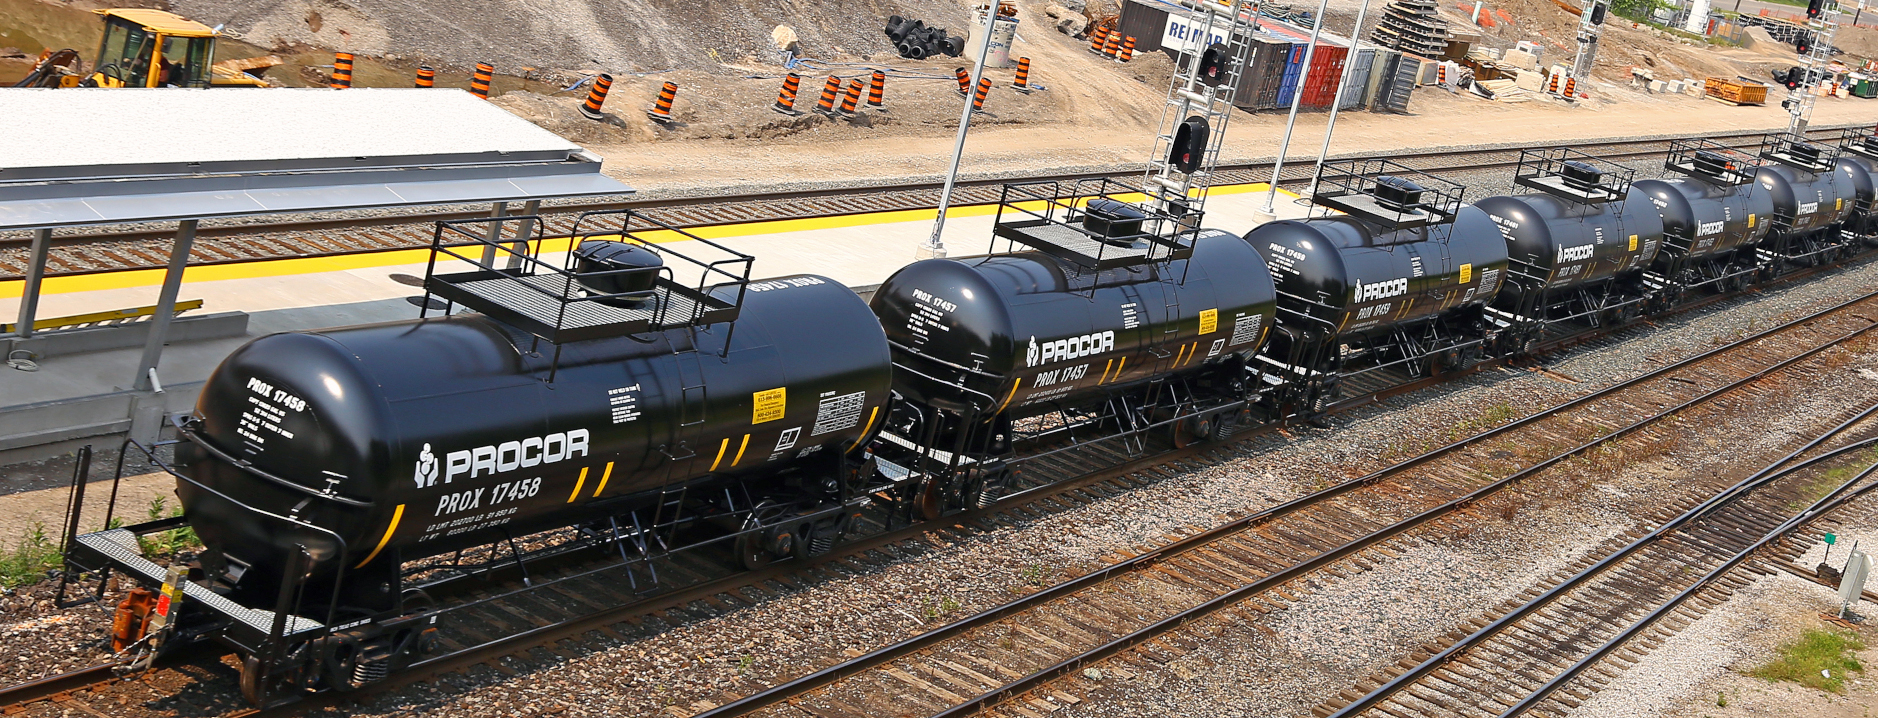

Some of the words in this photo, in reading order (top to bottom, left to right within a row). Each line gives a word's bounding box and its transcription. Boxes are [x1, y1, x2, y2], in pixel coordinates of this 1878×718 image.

[1701, 220, 1724, 236] PROCOR
[1269, 242, 1286, 253] PROX
[1563, 244, 1594, 263] PROCOR
[912, 288, 933, 304] PROX
[933, 298, 957, 313] 17457
[1363, 277, 1408, 302] PROCOR
[1041, 330, 1115, 365] PROCOR
[1033, 369, 1060, 389] PROX
[1061, 364, 1089, 383] 17457
[247, 377, 274, 397] PROX
[273, 390, 306, 412] 17458
[444, 428, 590, 484] PROCOR
[434, 487, 485, 516] PROX
[490, 477, 542, 505] 17458
